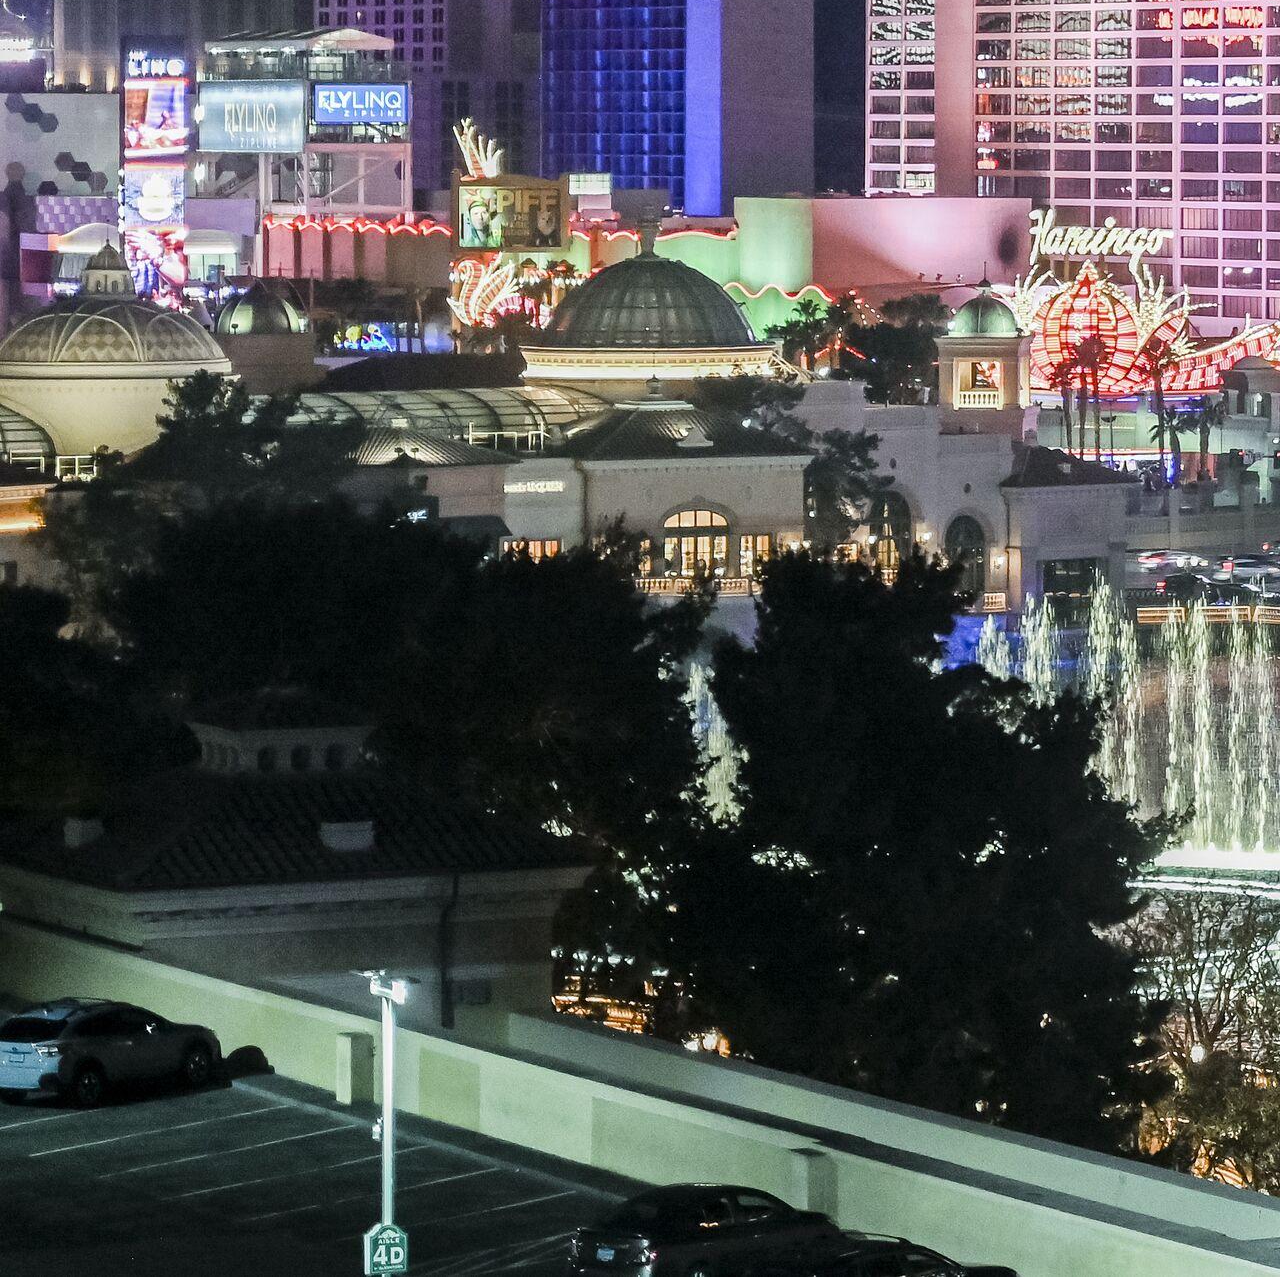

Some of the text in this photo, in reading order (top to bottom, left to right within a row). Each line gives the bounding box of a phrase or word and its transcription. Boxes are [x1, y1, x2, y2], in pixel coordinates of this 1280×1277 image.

[318, 90, 401, 109] FLYLINQ
[224, 103, 277, 133] FLYLINQ
[343, 109, 402, 117] ZIPLINE
[240, 137, 277, 149] ZIPLINE
[496, 189, 559, 213] PIFF
[1028, 208, 1175, 272] Flamingo
[372, 1244, 405, 1265] 4D
